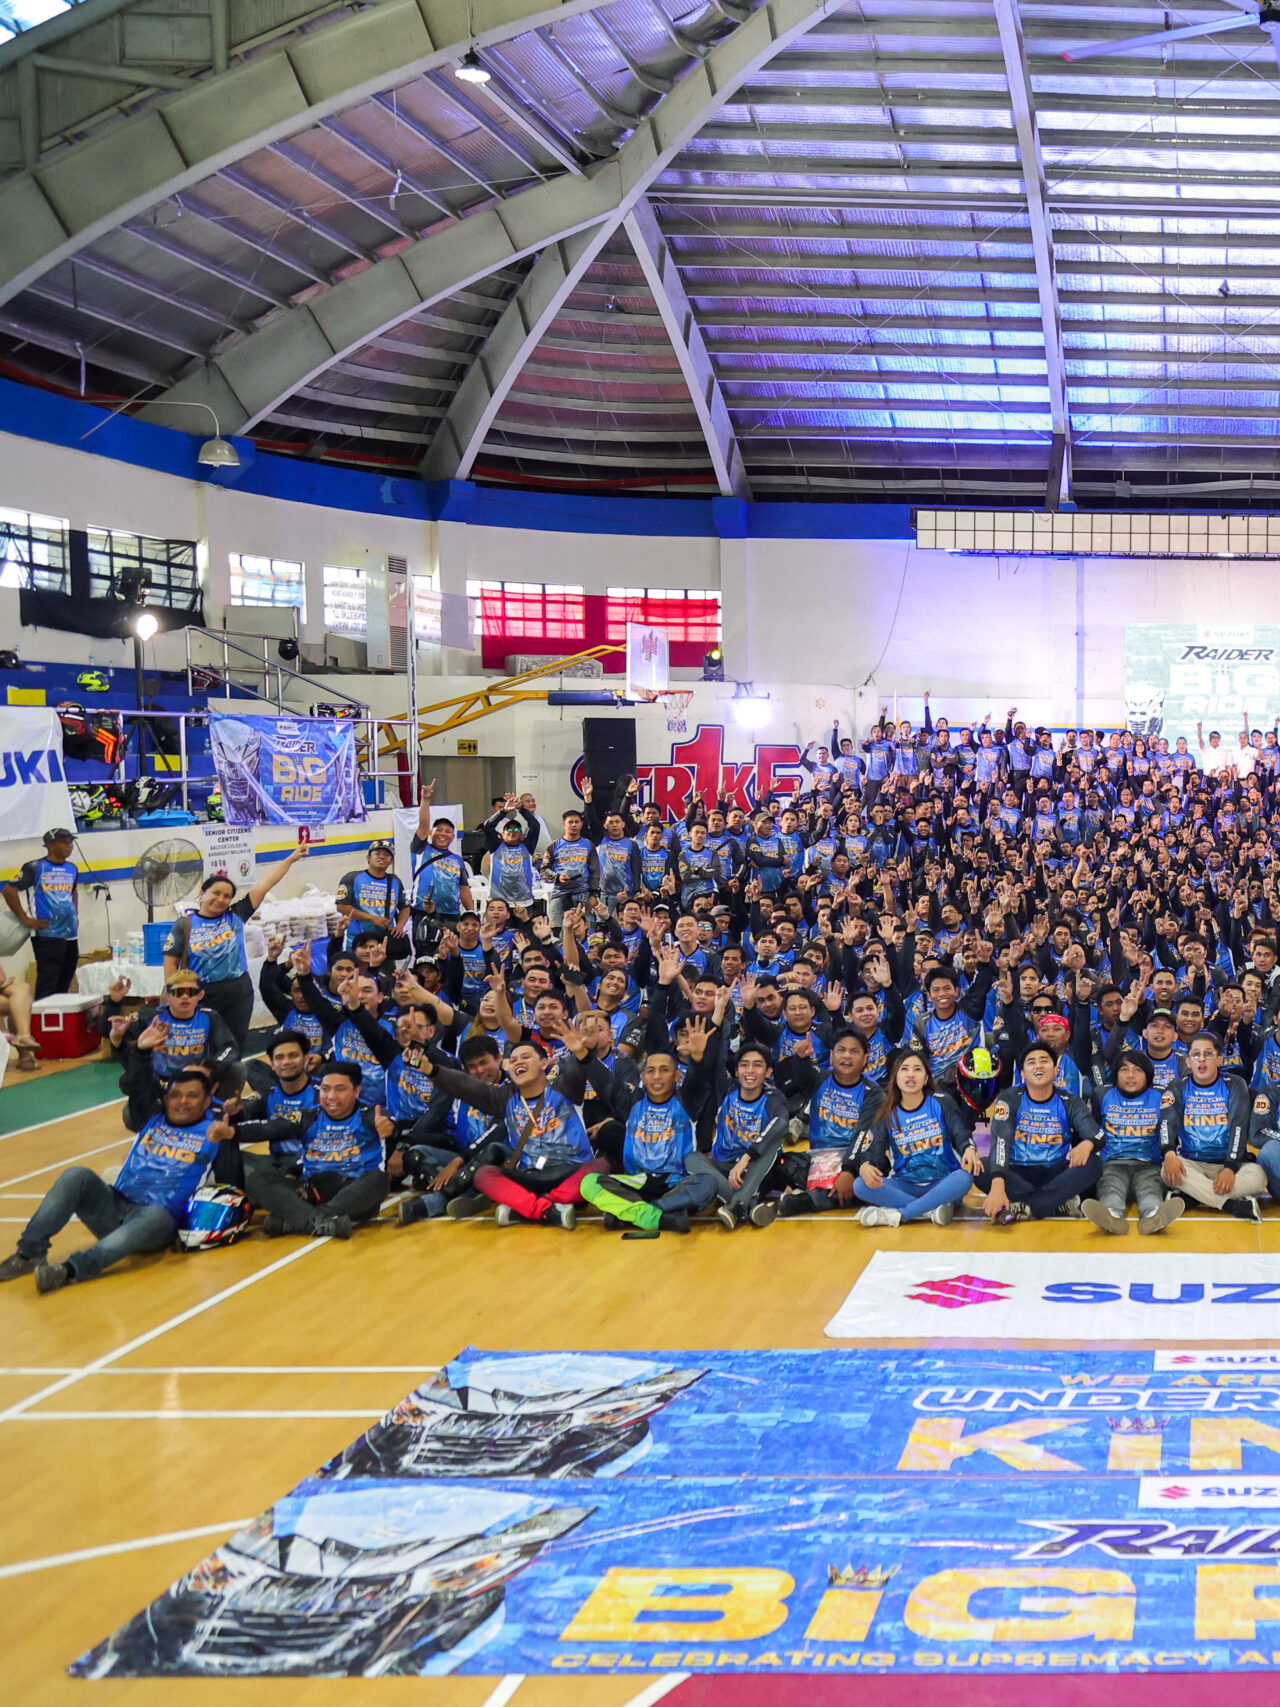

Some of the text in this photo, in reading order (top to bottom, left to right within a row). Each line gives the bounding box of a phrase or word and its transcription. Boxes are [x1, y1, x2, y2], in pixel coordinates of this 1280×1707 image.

[1181, 646, 1274, 661] RAIDER
[1183, 696, 1268, 713] RIDE
[281, 786, 322, 802] RIDE
[205, 827, 251, 837] SENIOR CITIZENS
[1060, 1372, 1140, 1387] WE
[551, 1651, 896, 1669] CELEBRATING
[912, 1650, 1217, 1668] SUPREMACY
